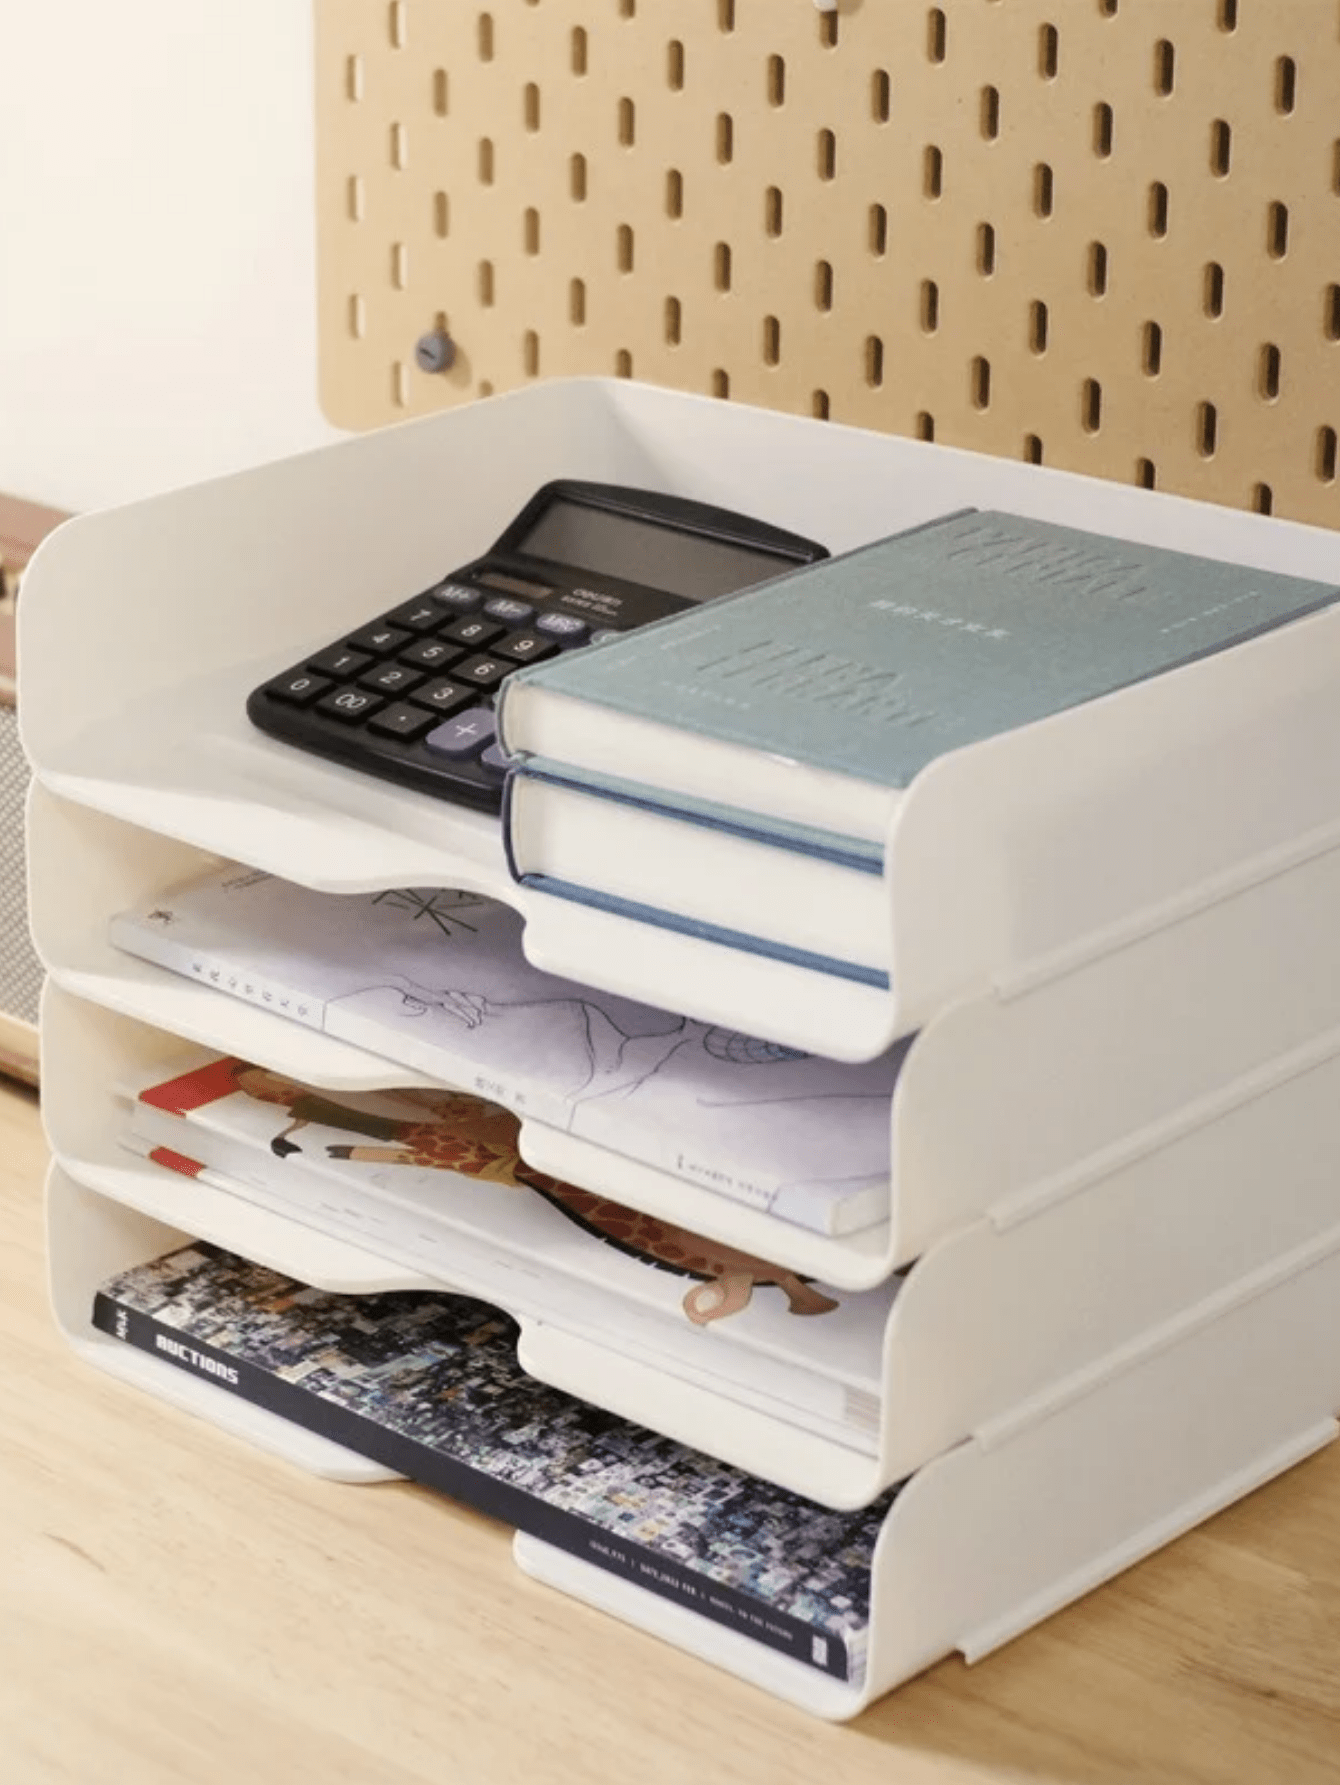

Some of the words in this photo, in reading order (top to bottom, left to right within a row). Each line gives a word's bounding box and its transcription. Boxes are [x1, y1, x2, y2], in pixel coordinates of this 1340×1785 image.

[410, 609, 432, 622] 7
[460, 624, 482, 637] 8
[372, 633, 391, 644] 4
[513, 639, 535, 652] 9
[421, 646, 444, 659] 5
[333, 656, 350, 668] 1
[473, 662, 496, 675] 6
[379, 671, 402, 684] 2
[290, 678, 311, 691] 0
[433, 686, 453, 700] 3
[335, 693, 368, 709] 00
[155, 1333, 239, 1385] AUCTIONS
